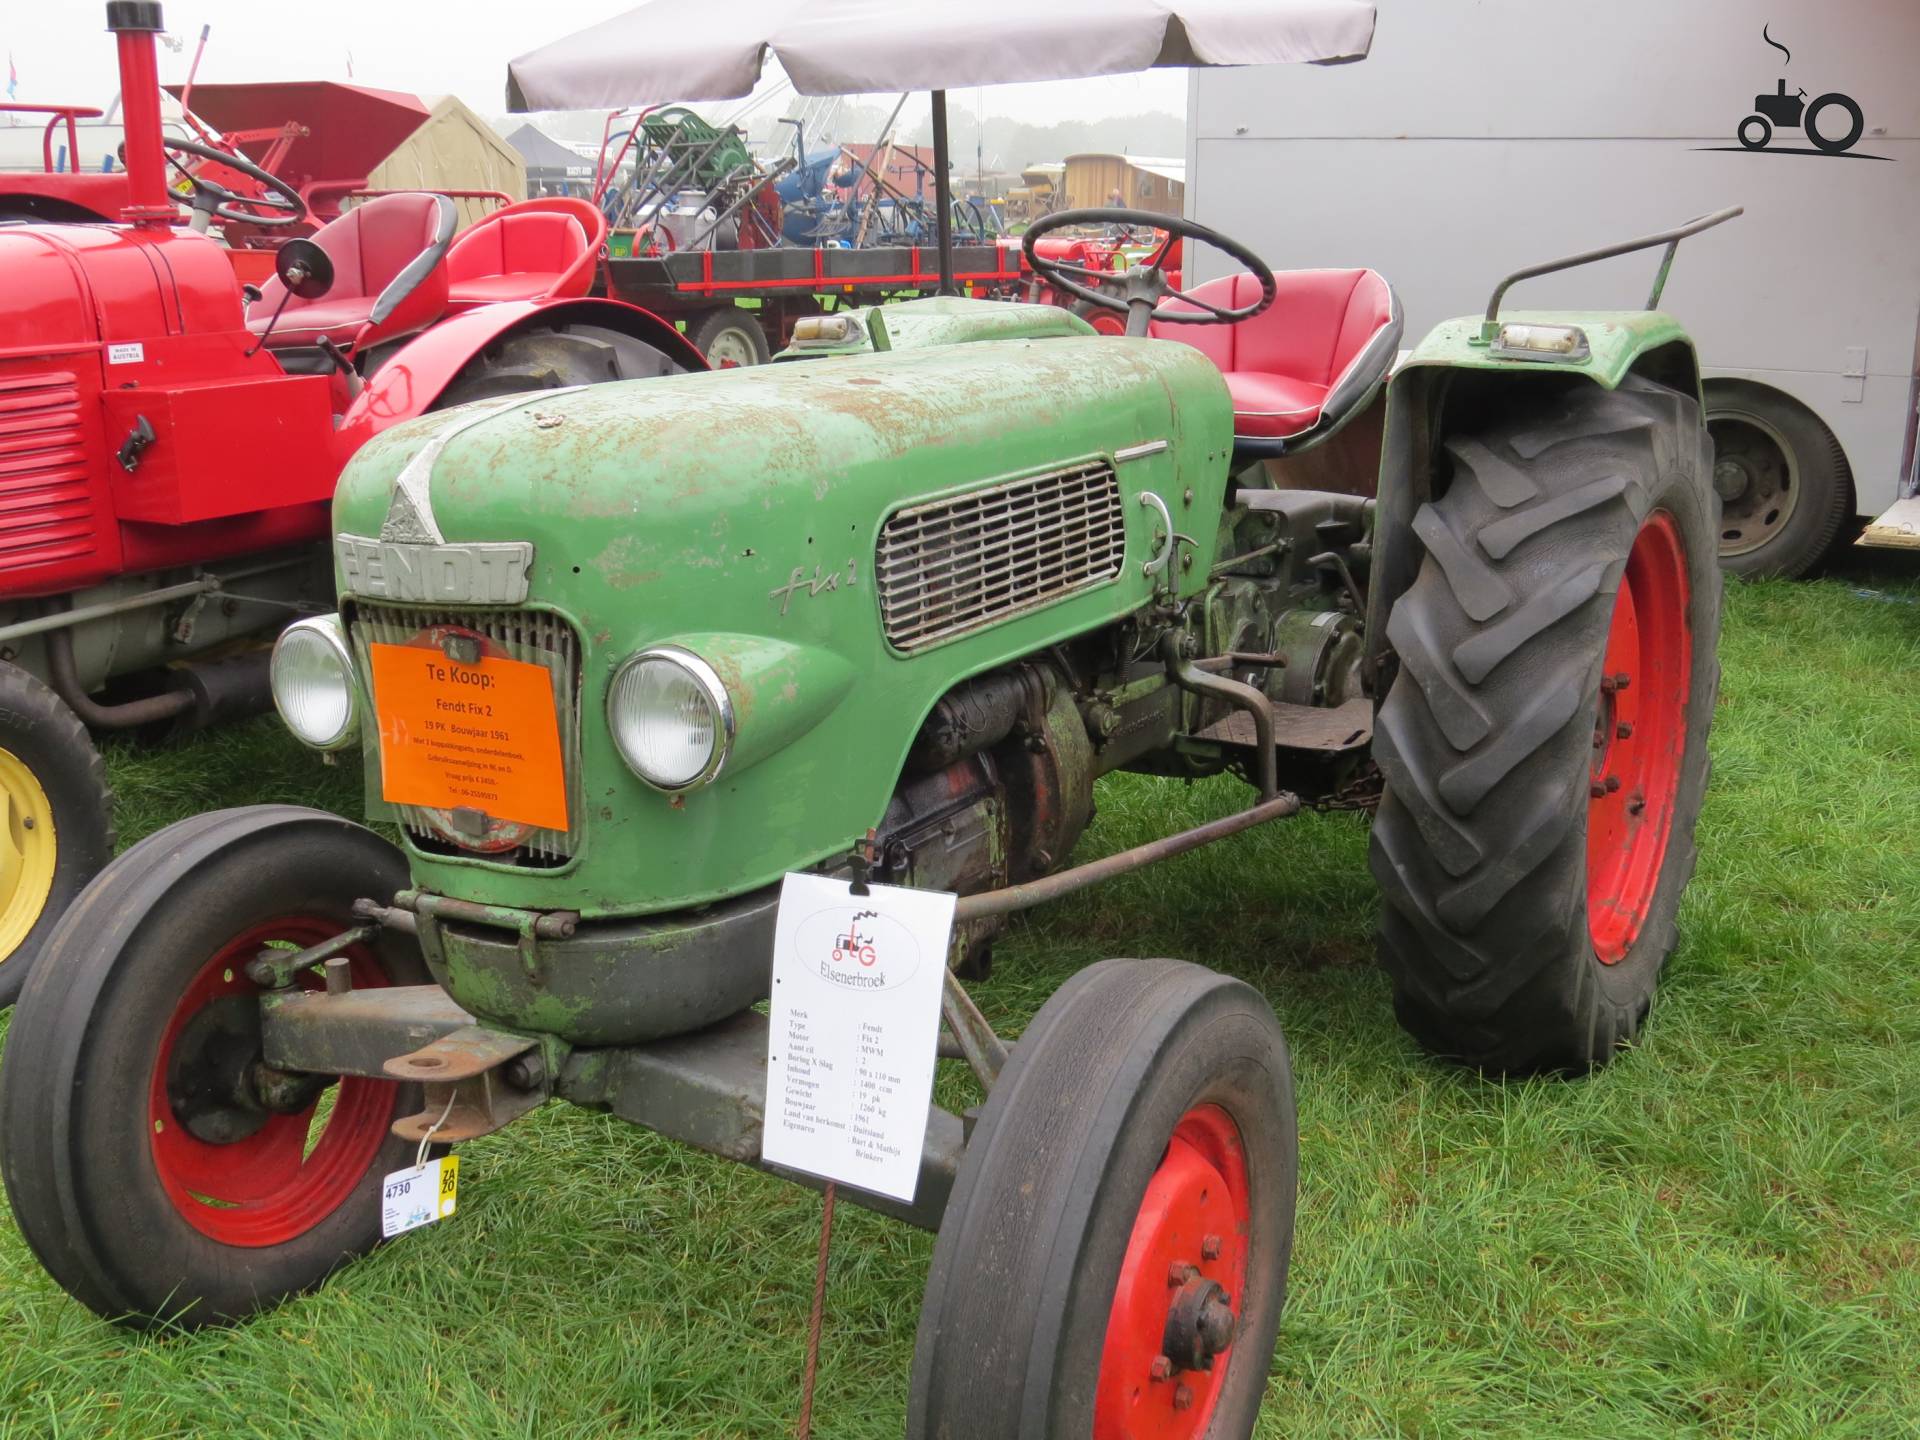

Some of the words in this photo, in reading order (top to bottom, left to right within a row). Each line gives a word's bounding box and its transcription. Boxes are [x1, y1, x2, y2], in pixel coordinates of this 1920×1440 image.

[113, 352, 140, 360] AUSTRIA
[343, 541, 524, 602] FENDT
[426, 664, 445, 681] Te
[451, 666, 495, 690] Koop:
[436, 698, 466, 714] Fendt
[469, 703, 484, 716] Fix
[485, 705, 493, 717] 2
[424, 720, 434, 730] 19
[451, 724, 488, 739] Bouwjaar
[490, 730, 510, 742] 1961
[789, 1019, 806, 1031] Type
[861, 1034, 873, 1043] Fix
[874, 1036, 880, 1045] 2
[790, 1008, 808, 1019] Merk
[862, 1022, 883, 1033] Fendt
[788, 1030, 809, 1042] Motor
[861, 1045, 884, 1057] MWM
[787, 1053, 810, 1066] Boring
[811, 1057, 817, 1066] X
[818, 1059, 833, 1071] Slag
[874, 1071, 887, 1081] 110
[862, 1056, 867, 1065] 2
[786, 1074, 820, 1089] Vermogen
[859, 1090, 867, 1099] 19
[787, 1064, 811, 1076] Inhoud
[860, 1080, 876, 1091] 1400
[785, 1086, 812, 1099] Gewicht
[878, 1107, 887, 1118] kg
[785, 1097, 816, 1111] Bouwjaar
[855, 1113, 869, 1125] 1961
[784, 1108, 801, 1118] Land
[802, 1113, 814, 1122] van
[815, 1116, 846, 1129] herkomst
[853, 1125, 885, 1139] Duitsland
[443, 1168, 456, 1181] ZA
[385, 1181, 411, 1200] 4730
